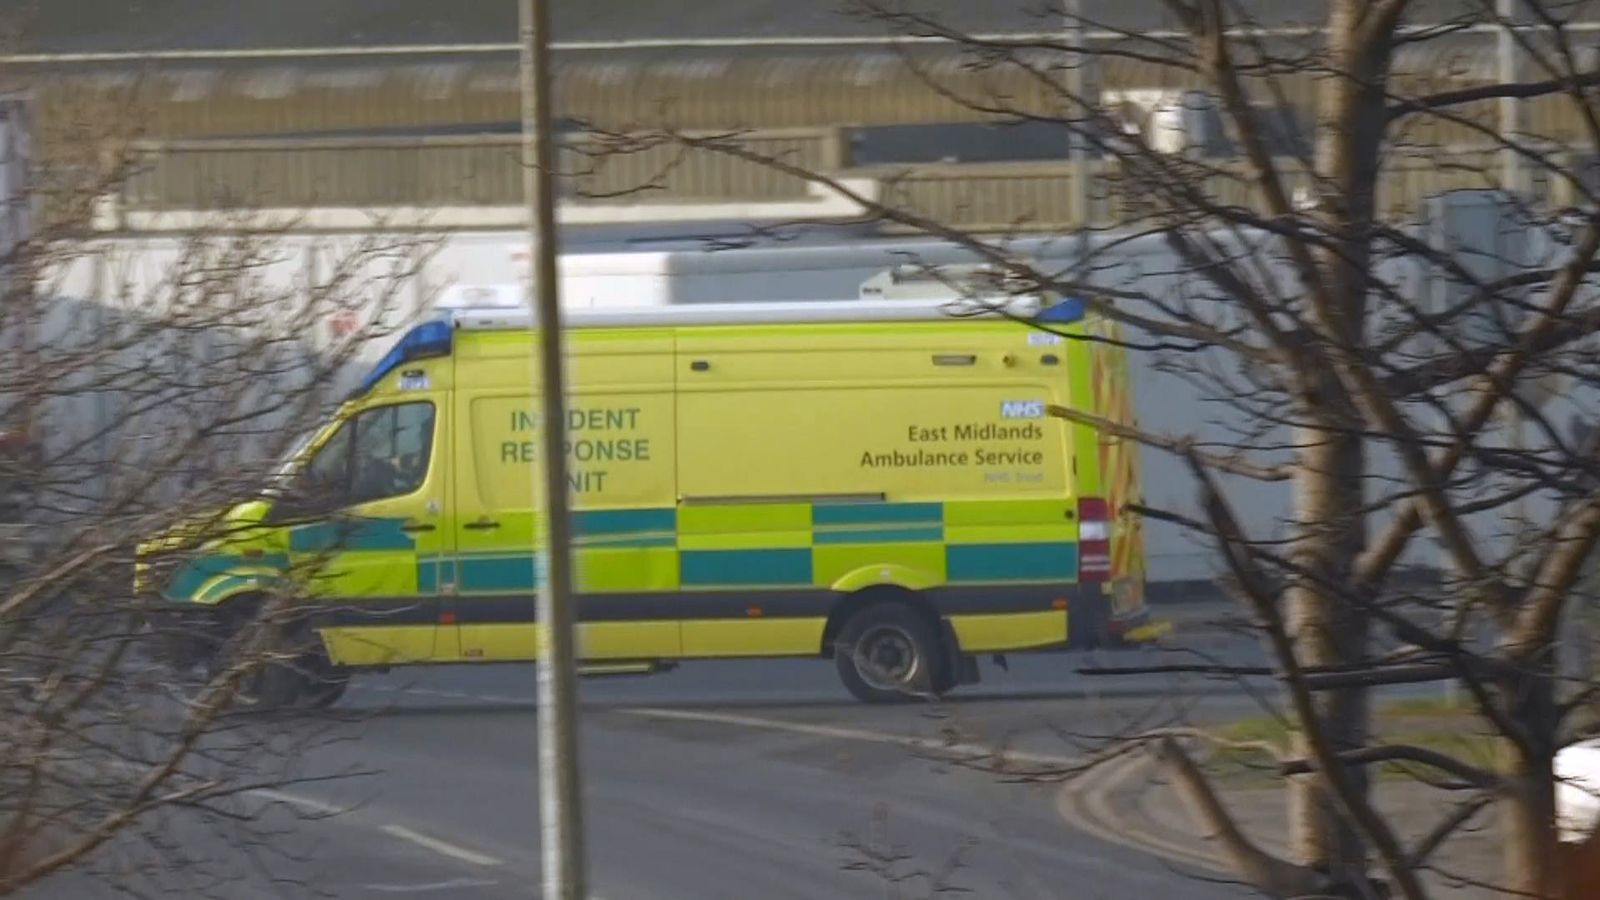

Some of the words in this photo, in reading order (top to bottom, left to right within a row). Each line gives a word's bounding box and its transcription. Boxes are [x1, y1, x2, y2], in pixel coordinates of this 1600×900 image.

[510, 408, 641, 431] INDENT
[1002, 400, 1043, 418] NHS
[907, 425, 948, 442] East
[954, 422, 1043, 441] Midlands
[501, 438, 651, 463] REPONSE
[860, 450, 969, 468] Ambulance
[975, 448, 1043, 465] Service
[555, 471, 607, 493] NIT
